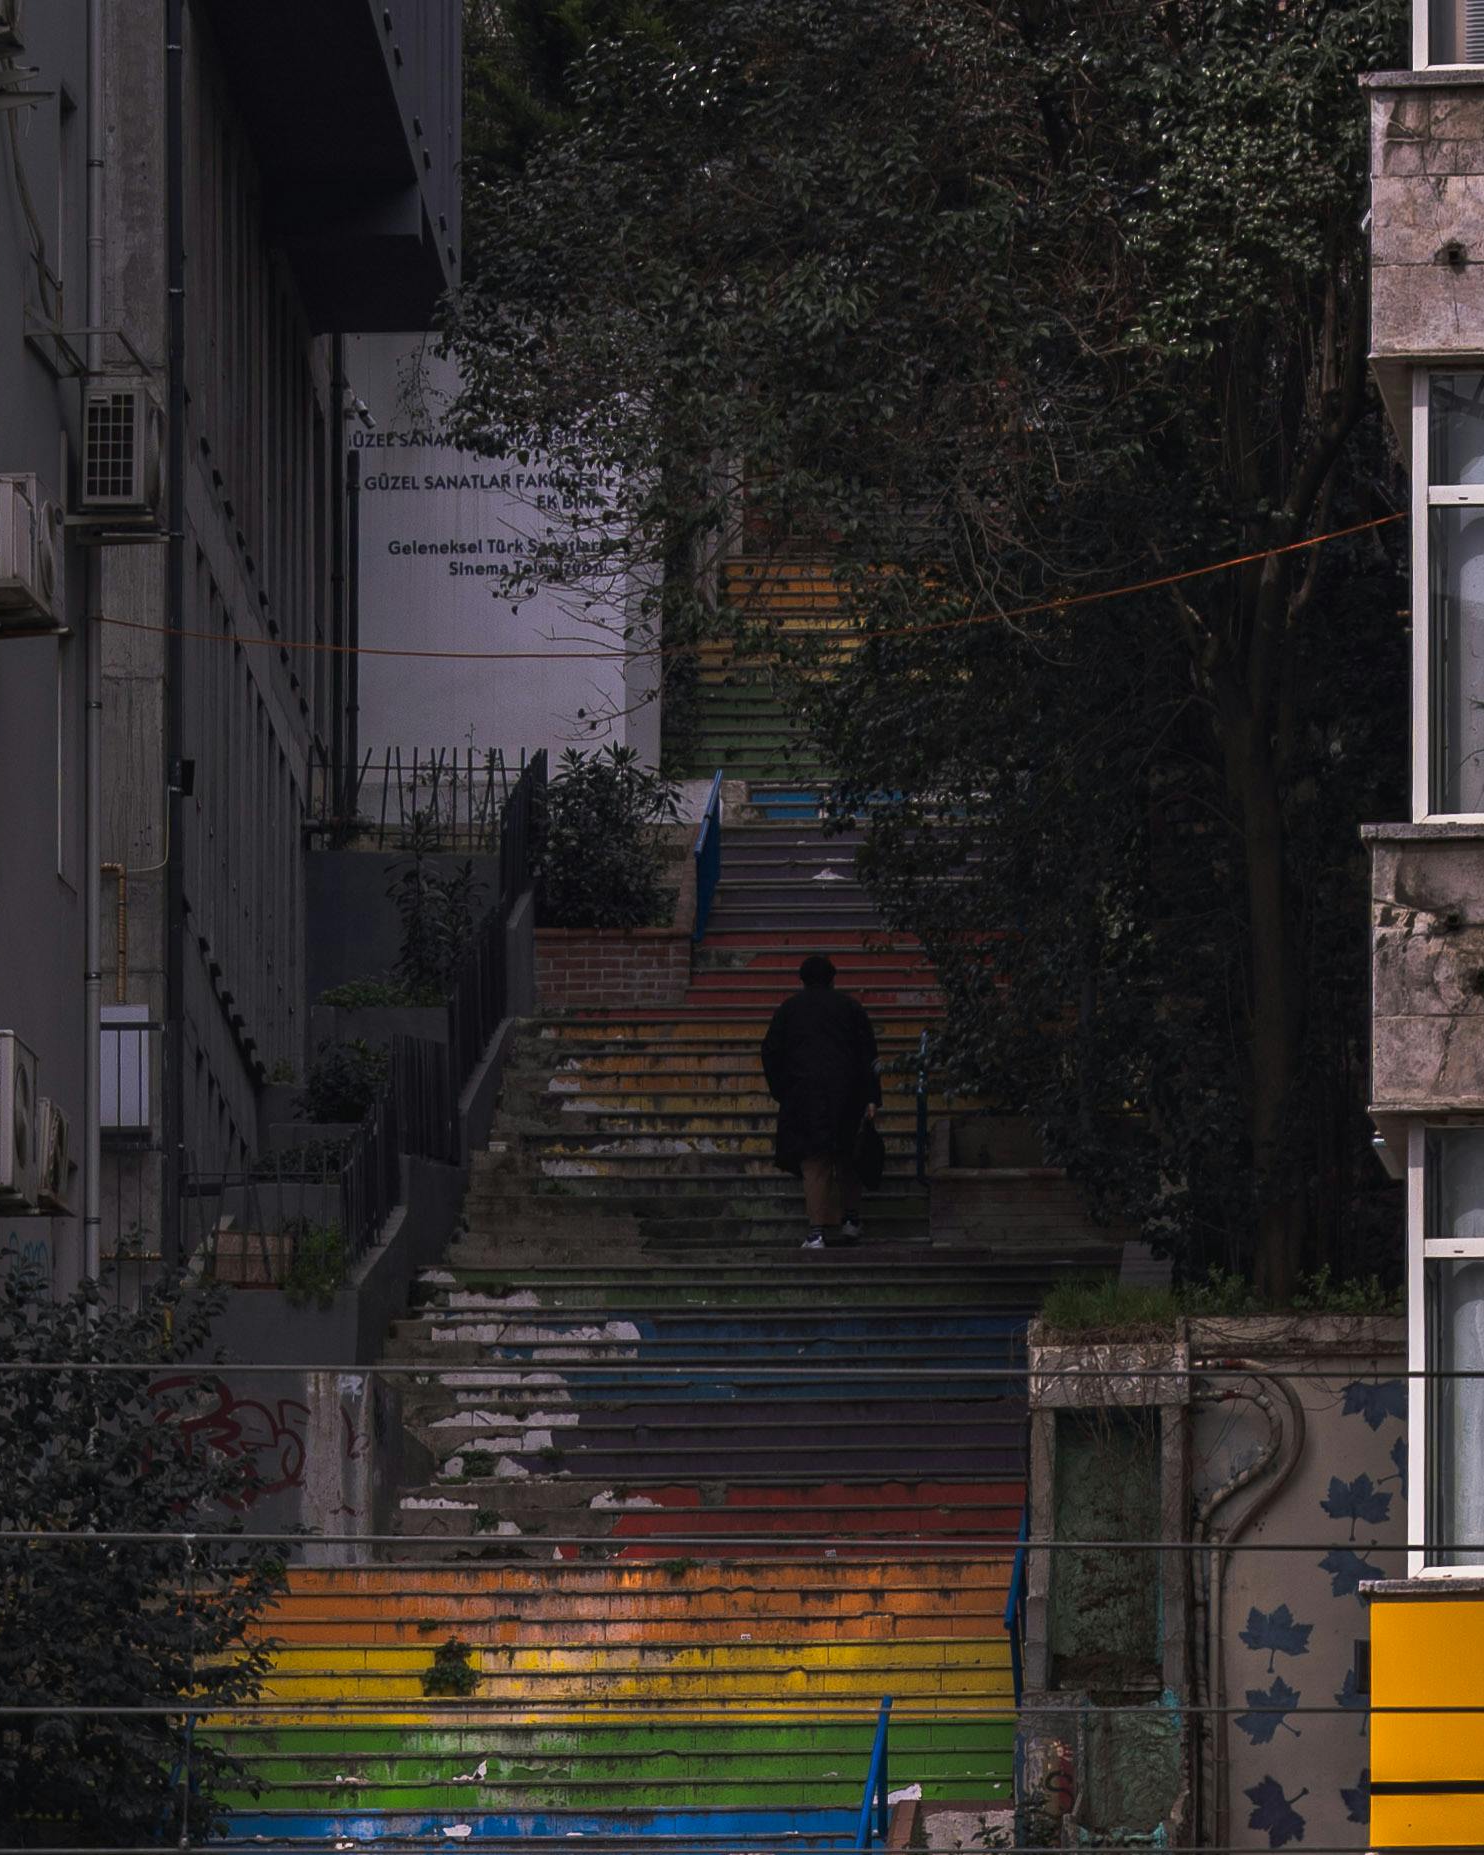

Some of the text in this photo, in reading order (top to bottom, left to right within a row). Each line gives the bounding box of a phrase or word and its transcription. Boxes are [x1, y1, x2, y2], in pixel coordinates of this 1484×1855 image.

[348, 430, 395, 448] ÜZEL
[364, 469, 604, 491] GÜZEL SANATLAR FAKÜTESİ
[537, 494, 558, 509] EK
[388, 539, 483, 555] Geleneksel
[487, 538, 524, 553] Türk
[449, 561, 509, 576] Sinema
